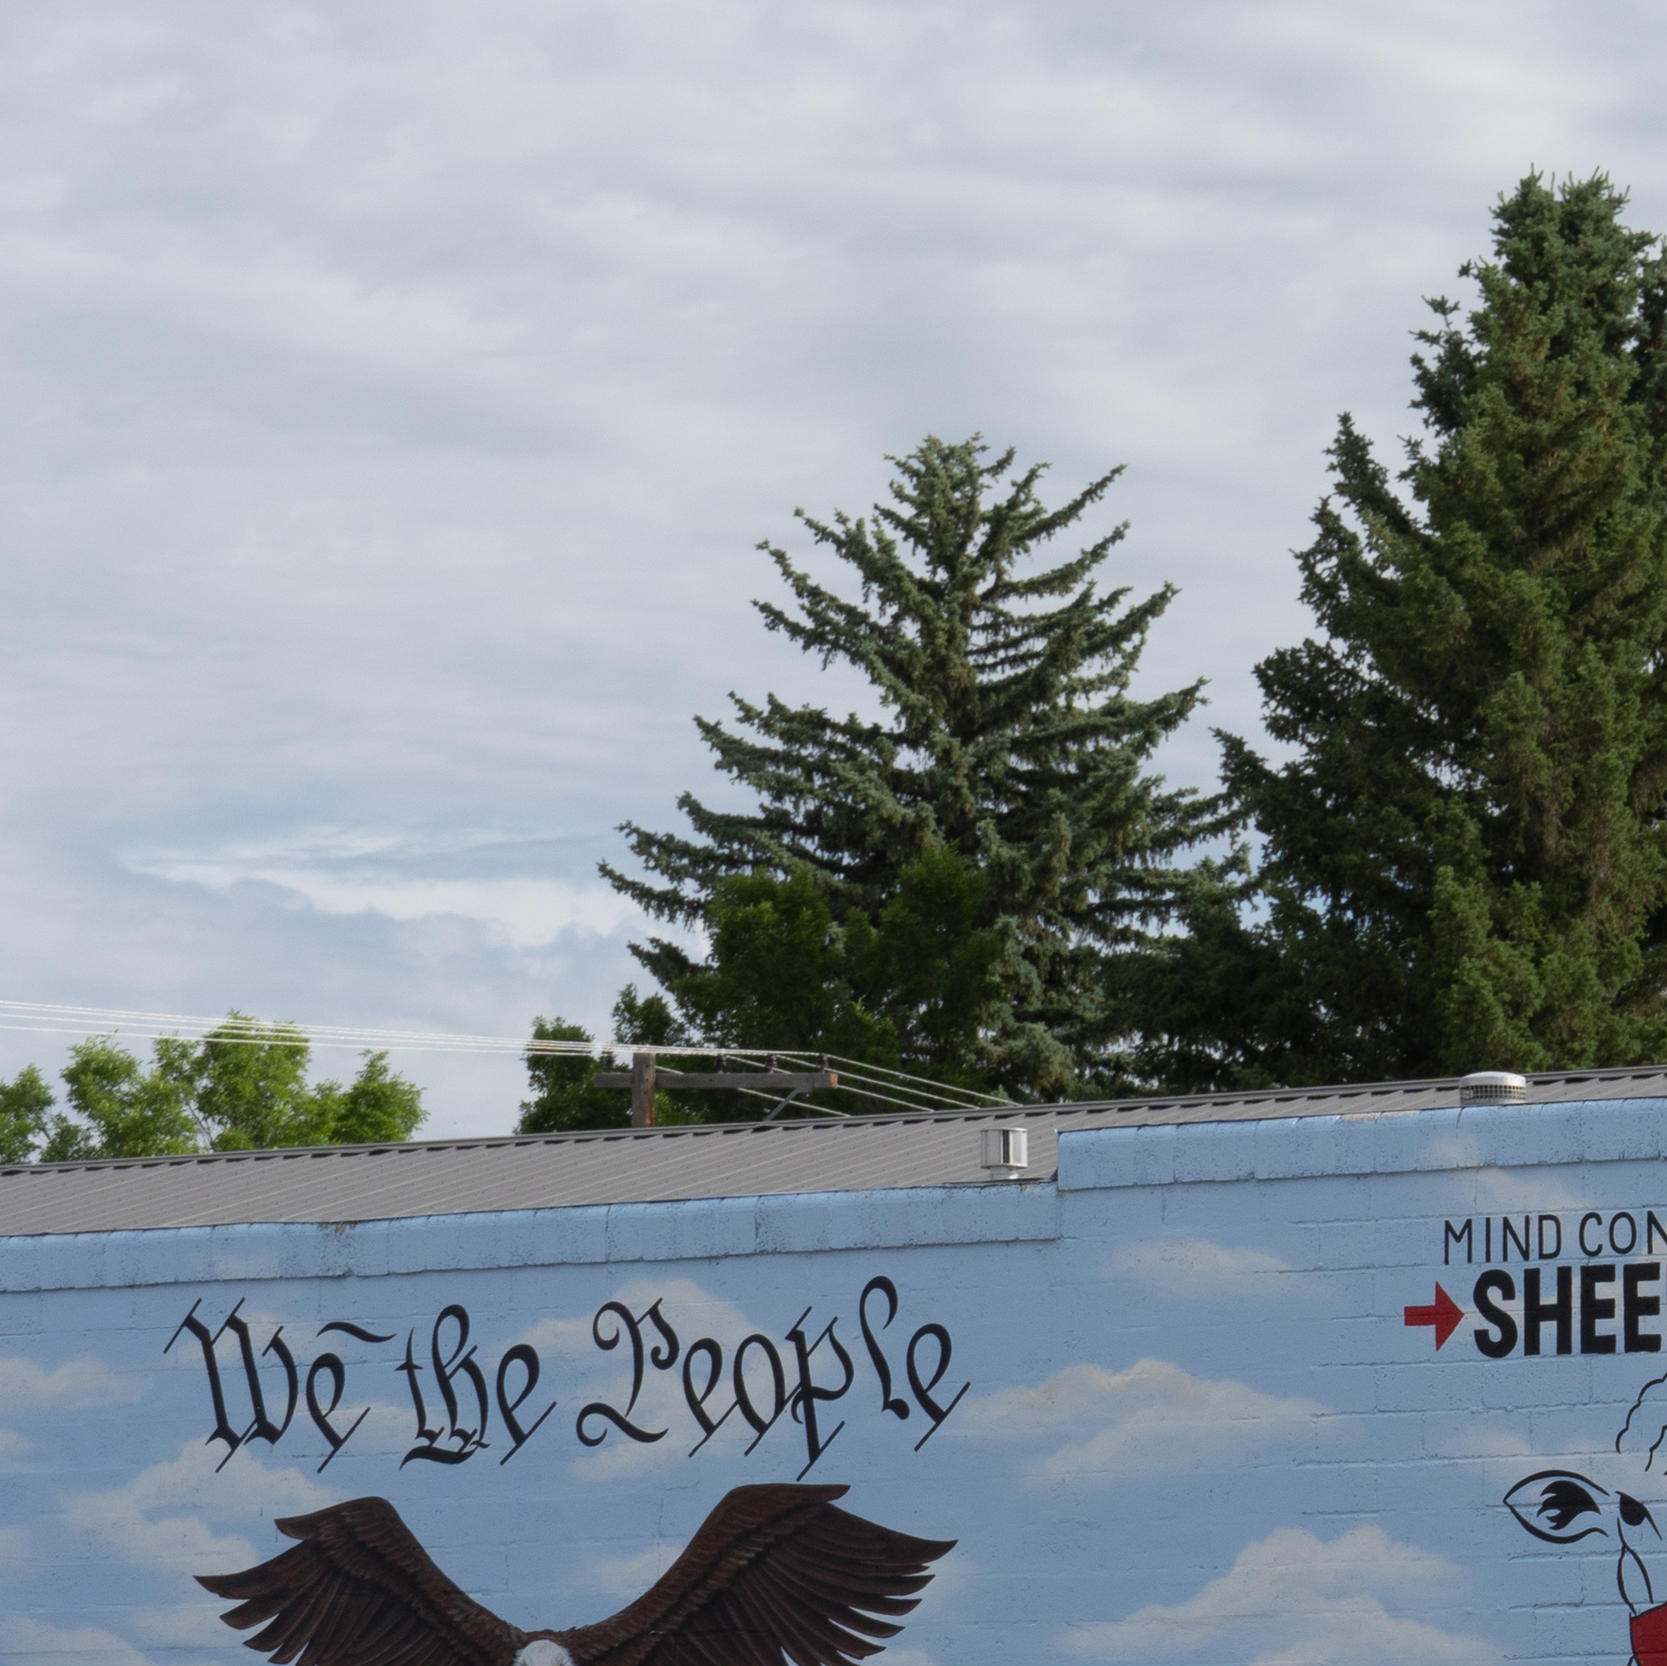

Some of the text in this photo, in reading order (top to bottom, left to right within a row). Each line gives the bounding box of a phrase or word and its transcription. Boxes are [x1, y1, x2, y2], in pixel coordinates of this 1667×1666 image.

[1444, 1214, 1562, 1266] MIND
[164, 1275, 971, 1482] We the People
